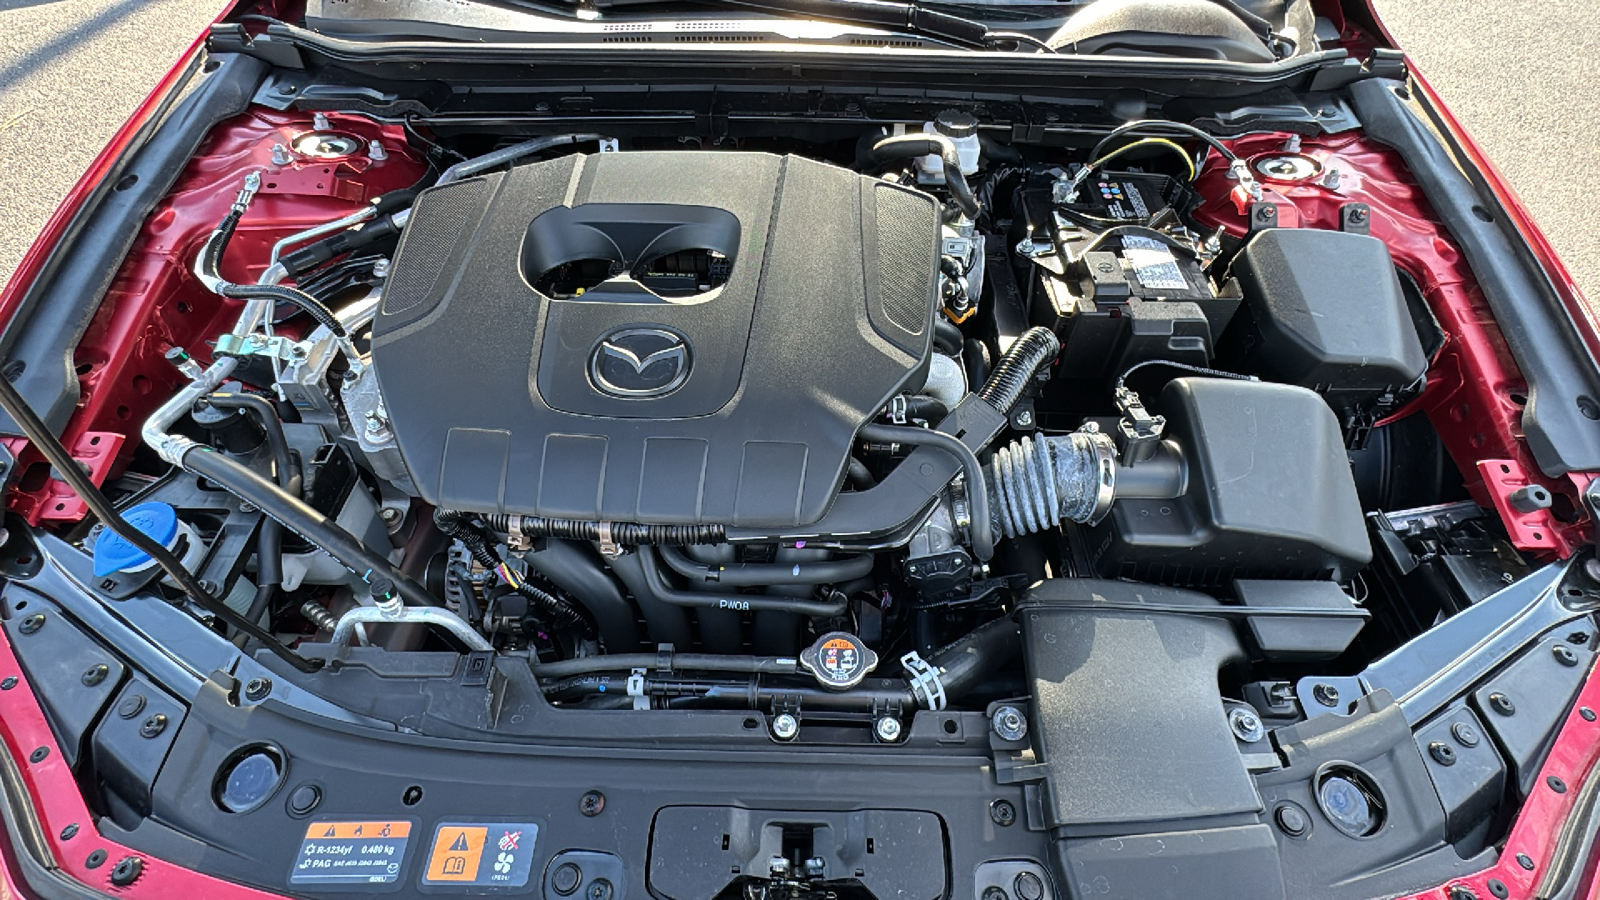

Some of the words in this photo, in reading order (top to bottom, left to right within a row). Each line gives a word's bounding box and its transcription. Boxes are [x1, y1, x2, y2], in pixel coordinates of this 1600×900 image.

[720, 599, 749, 610] PW08
[317, 845, 353, 855] R-1234yf
[384, 845, 395, 855] kg
[312, 859, 331, 868] PAG
